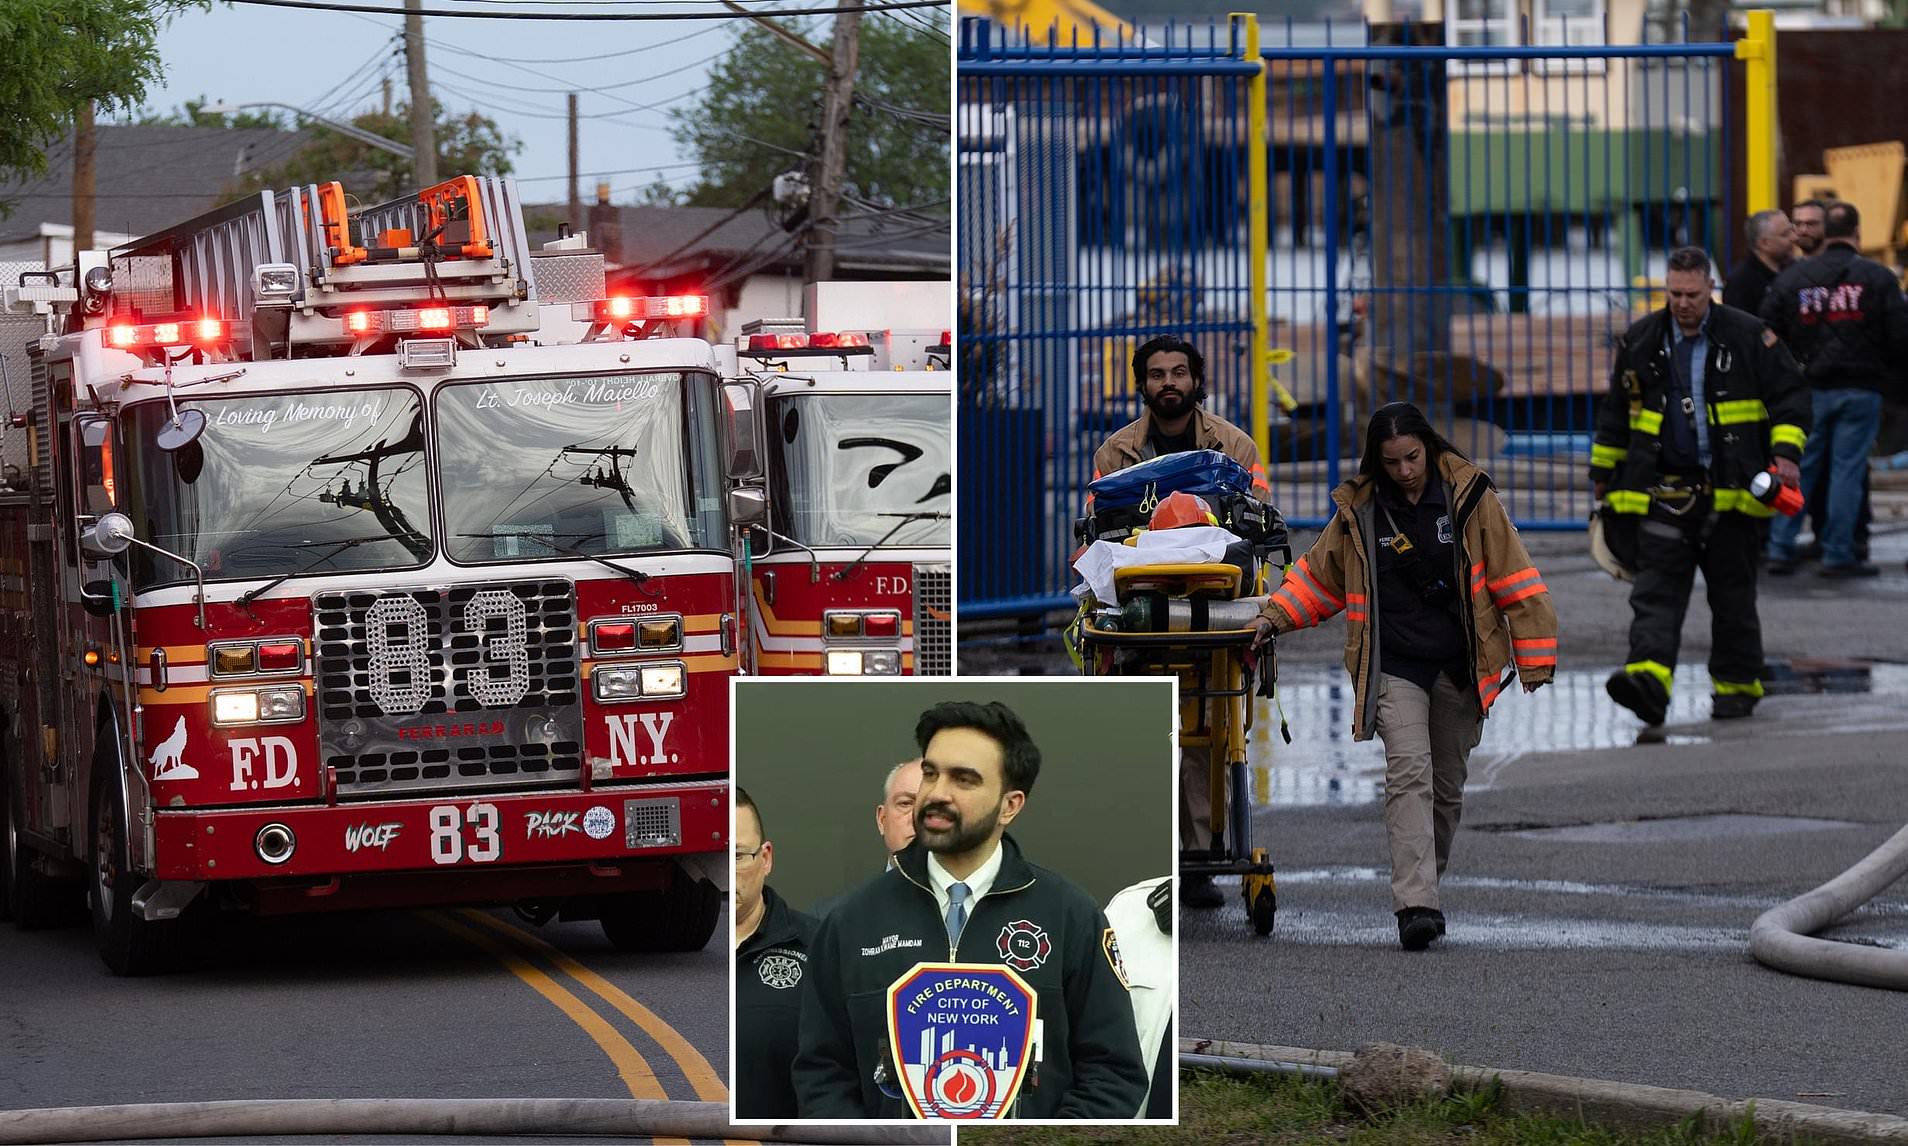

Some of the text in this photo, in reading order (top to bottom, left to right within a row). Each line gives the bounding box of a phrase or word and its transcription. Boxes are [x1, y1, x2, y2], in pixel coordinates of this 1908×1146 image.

[476, 381, 659, 411] Lt. Joseph Maiello
[216, 406, 277, 433] Loving
[282, 402, 358, 429] Memory
[361, 399, 382, 427] of
[876, 577, 912, 595] F.D.
[621, 603, 658, 613] FL17003
[365, 590, 531, 714] 83
[605, 712, 679, 768] N.Y.
[227, 736, 301, 792] F.D.
[344, 821, 405, 853] WOLF
[429, 803, 502, 865] 83
[523, 810, 582, 841] PACK
[1017, 939, 1030, 948] 112
[907, 978, 1019, 1016] FIRE DEPARTMENT
[938, 997, 990, 1009] CITY OF
[927, 1012, 999, 1025] NEW YORK
